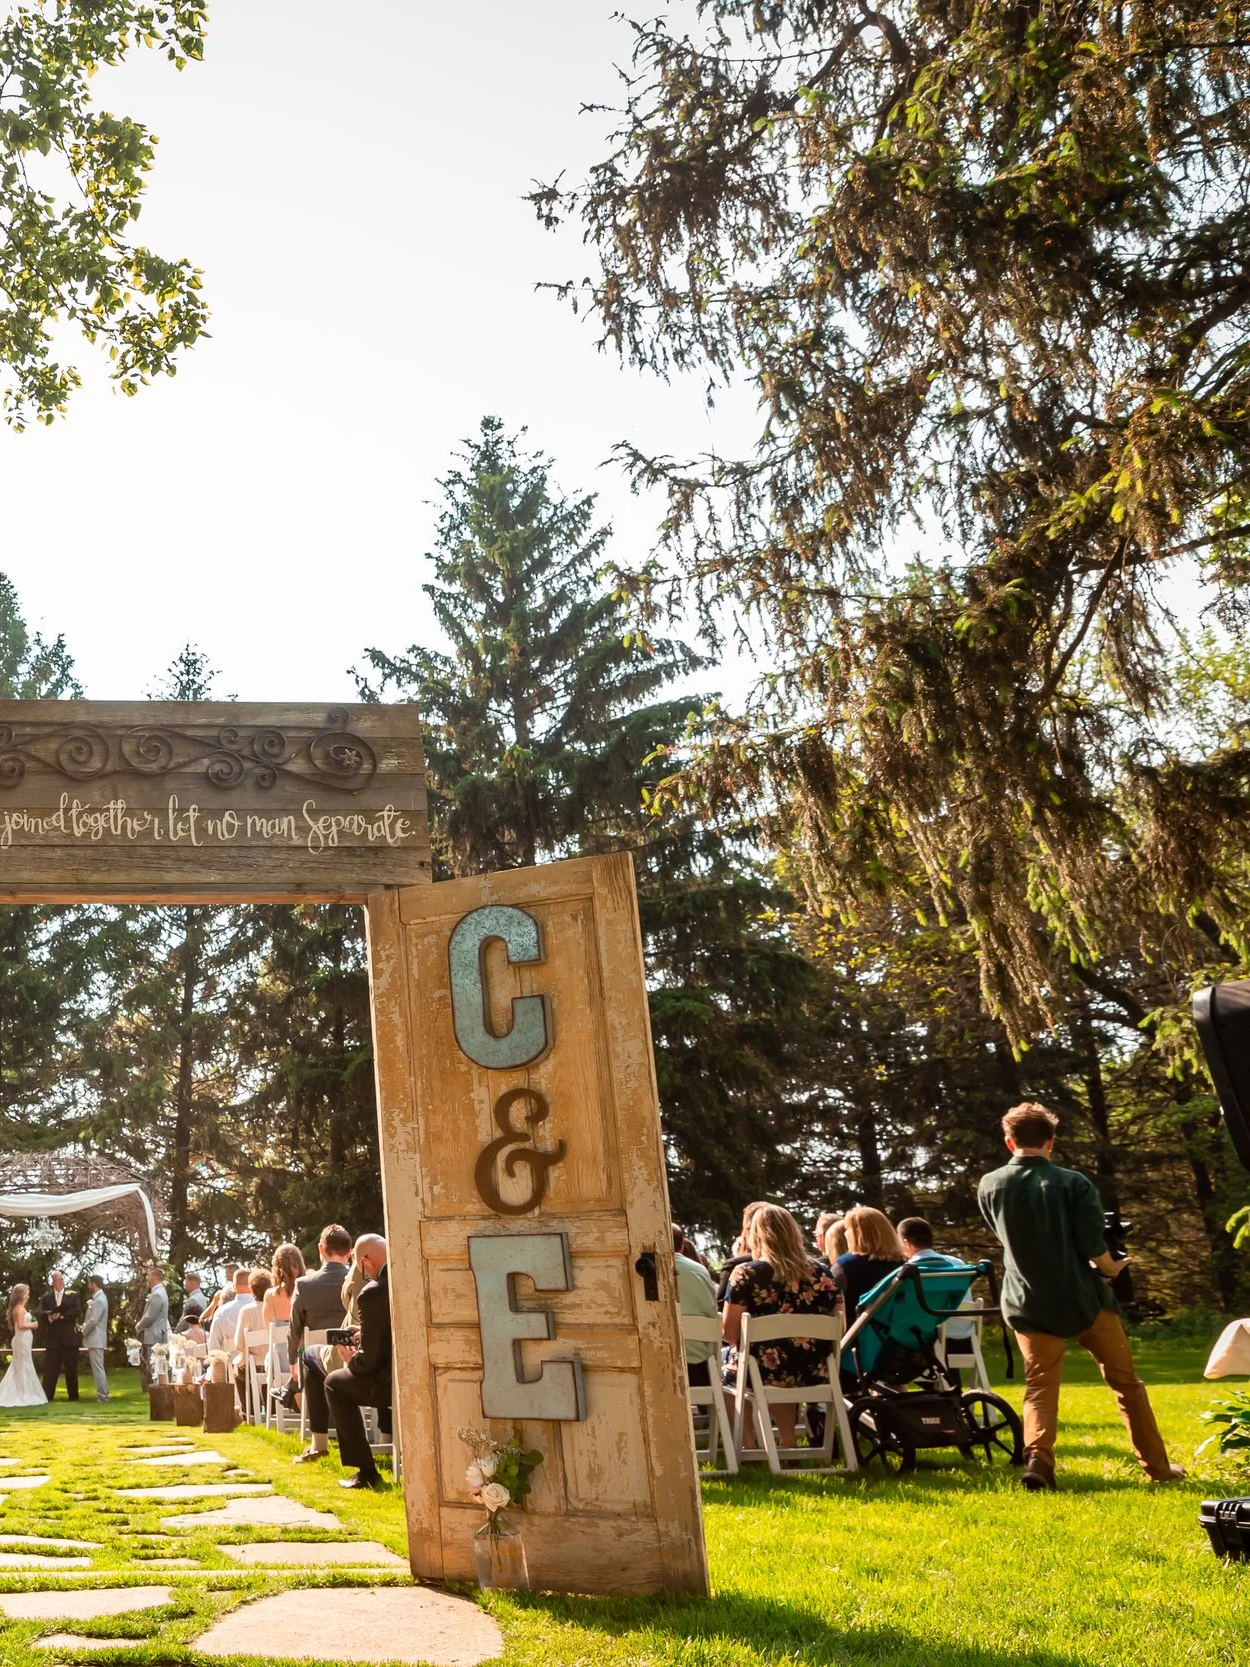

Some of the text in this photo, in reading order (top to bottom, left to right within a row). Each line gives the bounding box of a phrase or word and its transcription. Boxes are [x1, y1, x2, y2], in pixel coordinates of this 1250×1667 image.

[0, 792, 72, 849] joined
[168, 794, 203, 846] let
[246, 814, 299, 839] man
